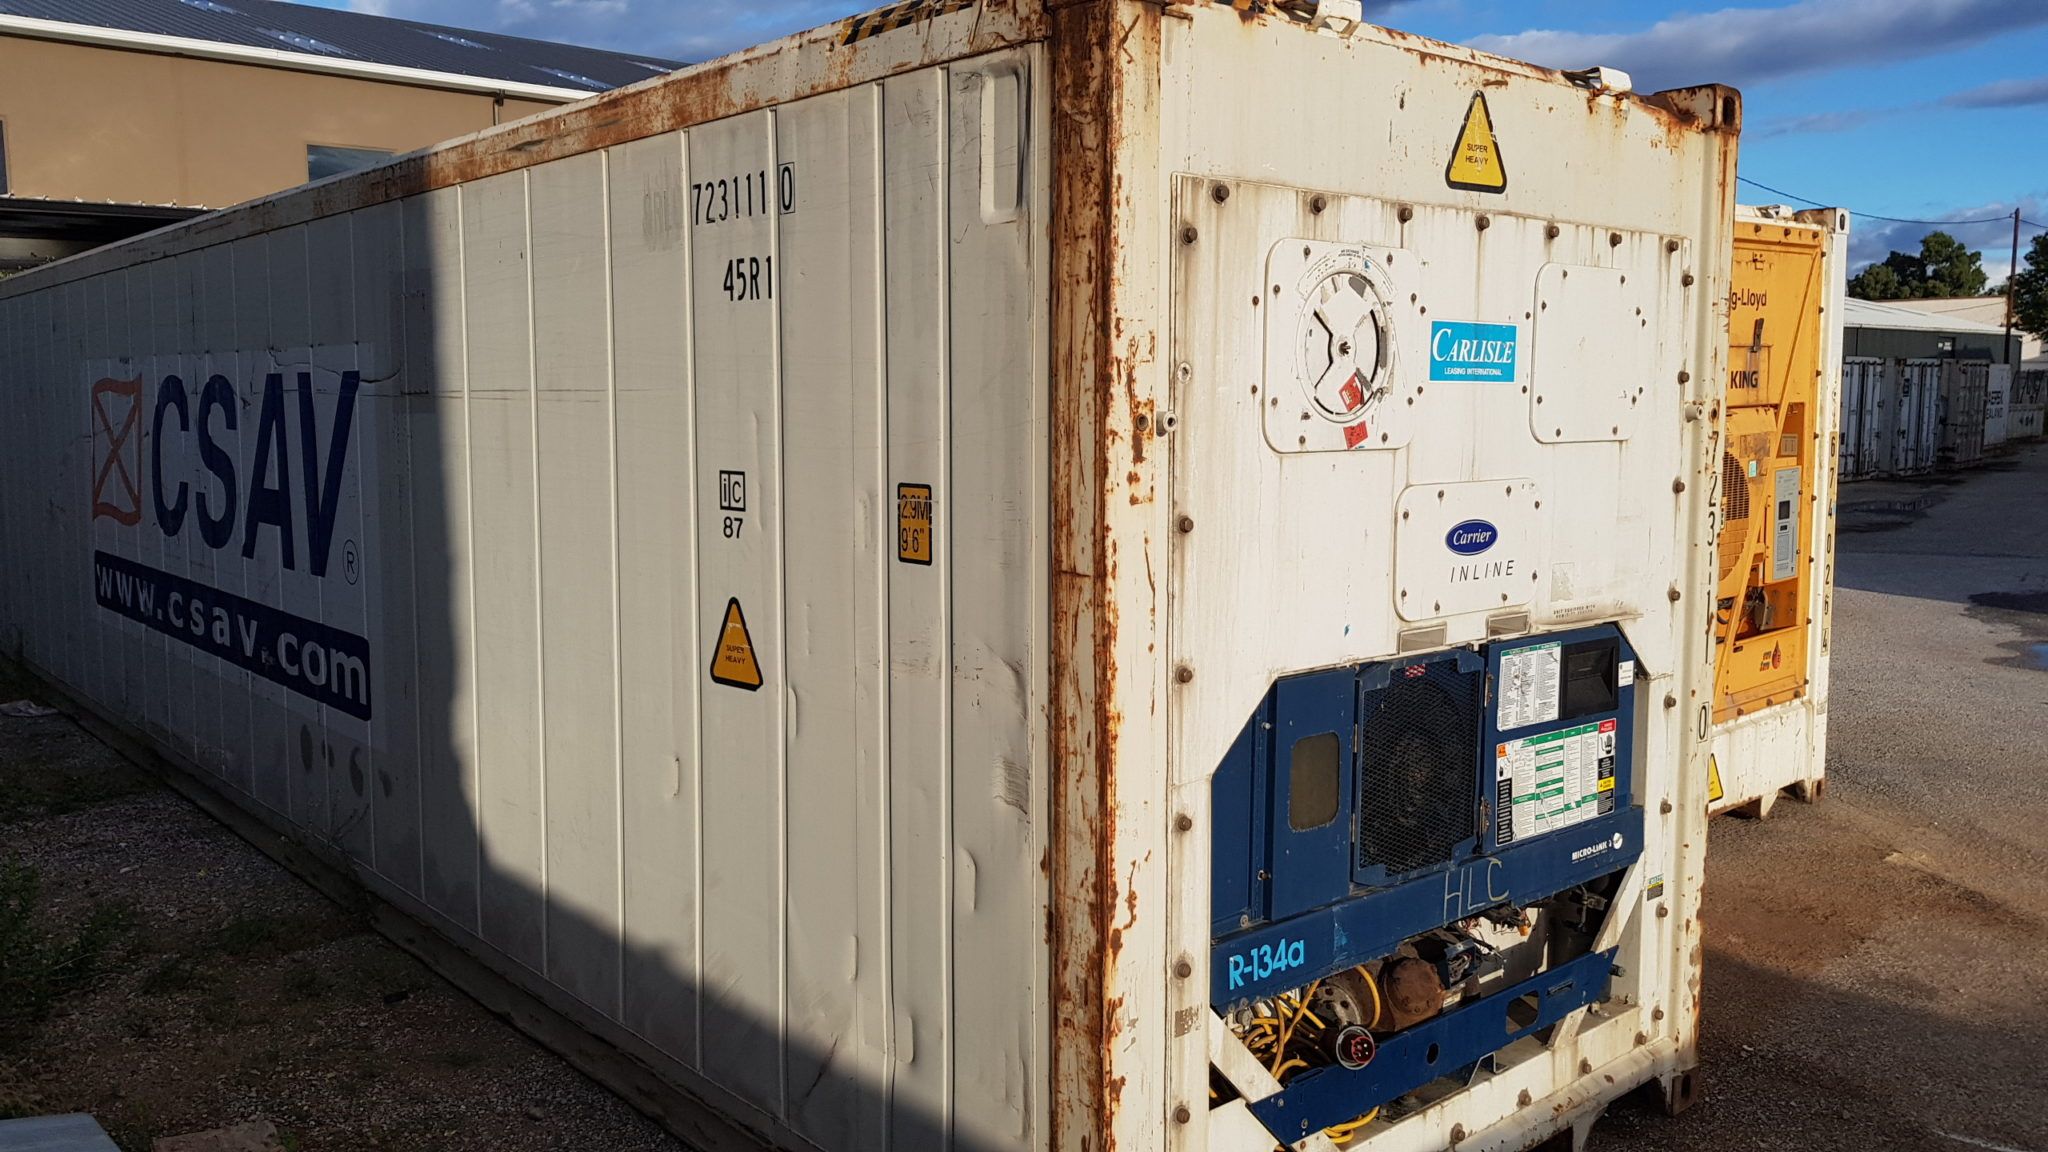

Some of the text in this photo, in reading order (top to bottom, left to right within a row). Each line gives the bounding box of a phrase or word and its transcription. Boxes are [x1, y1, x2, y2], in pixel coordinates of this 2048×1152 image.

[1465, 155, 1489, 165] HEAVY
[1466, 143, 1488, 153] SUPER
[692, 170, 766, 225] 723111
[723, 255, 772, 301] 45R1
[1432, 328, 1514, 364] CARLISLE
[1444, 367, 1503, 376] LEASING INTERNATIONAL
[1730, 370, 1759, 389] KING
[152, 370, 360, 578] CSAV
[901, 494, 929, 520] 2.9M
[723, 516, 743, 539] 87
[1452, 527, 1492, 545] Carrier
[1450, 559, 1515, 583] INLINE
[96, 563, 369, 706] www.csav.com
[725, 655, 746, 664] HEAVY
[1443, 857, 1510, 929] HLC
[1228, 938, 1306, 990] R-134a
